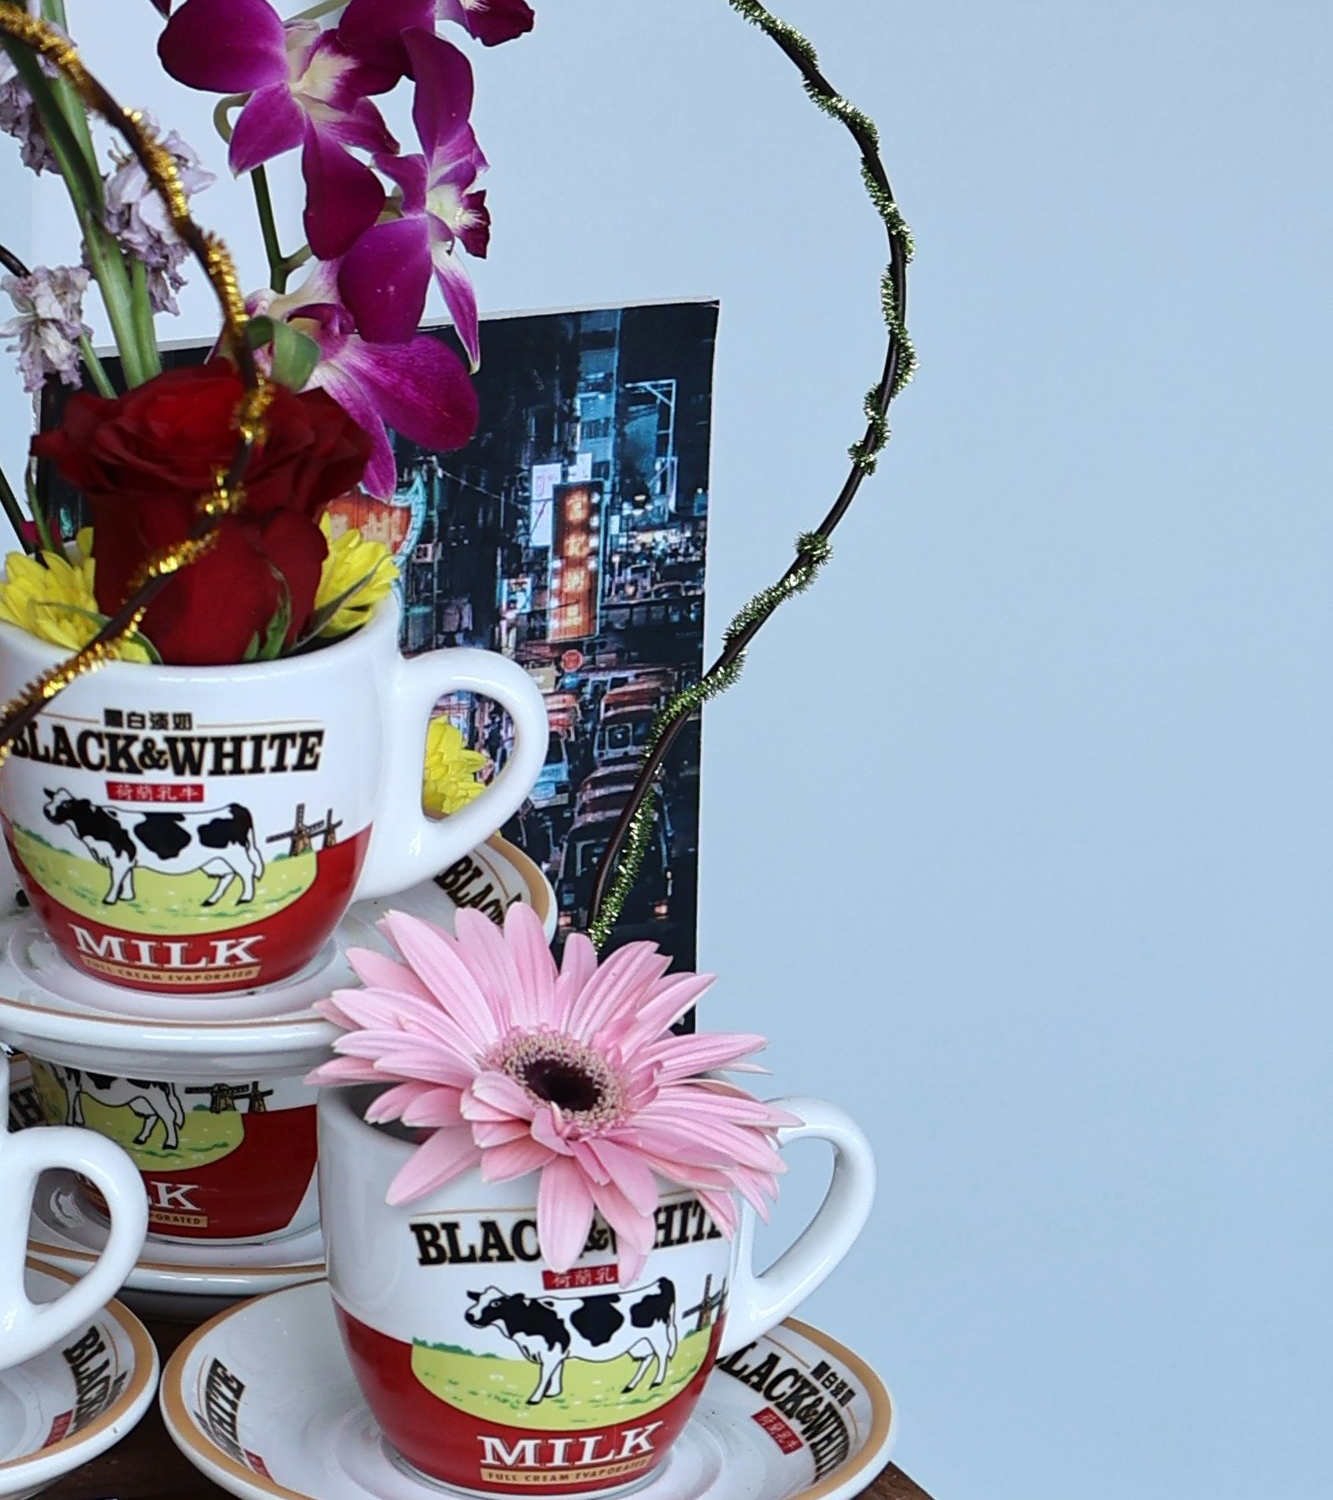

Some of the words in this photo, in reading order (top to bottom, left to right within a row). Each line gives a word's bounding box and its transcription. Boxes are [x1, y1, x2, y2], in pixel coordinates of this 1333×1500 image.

[103, 707, 193, 732] 黑白淡奶
[68, 922, 266, 969] MILK
[476, 1420, 664, 1468] MILK
[488, 1472, 518, 1482] FULL
[524, 1472, 570, 1482] CREAM
